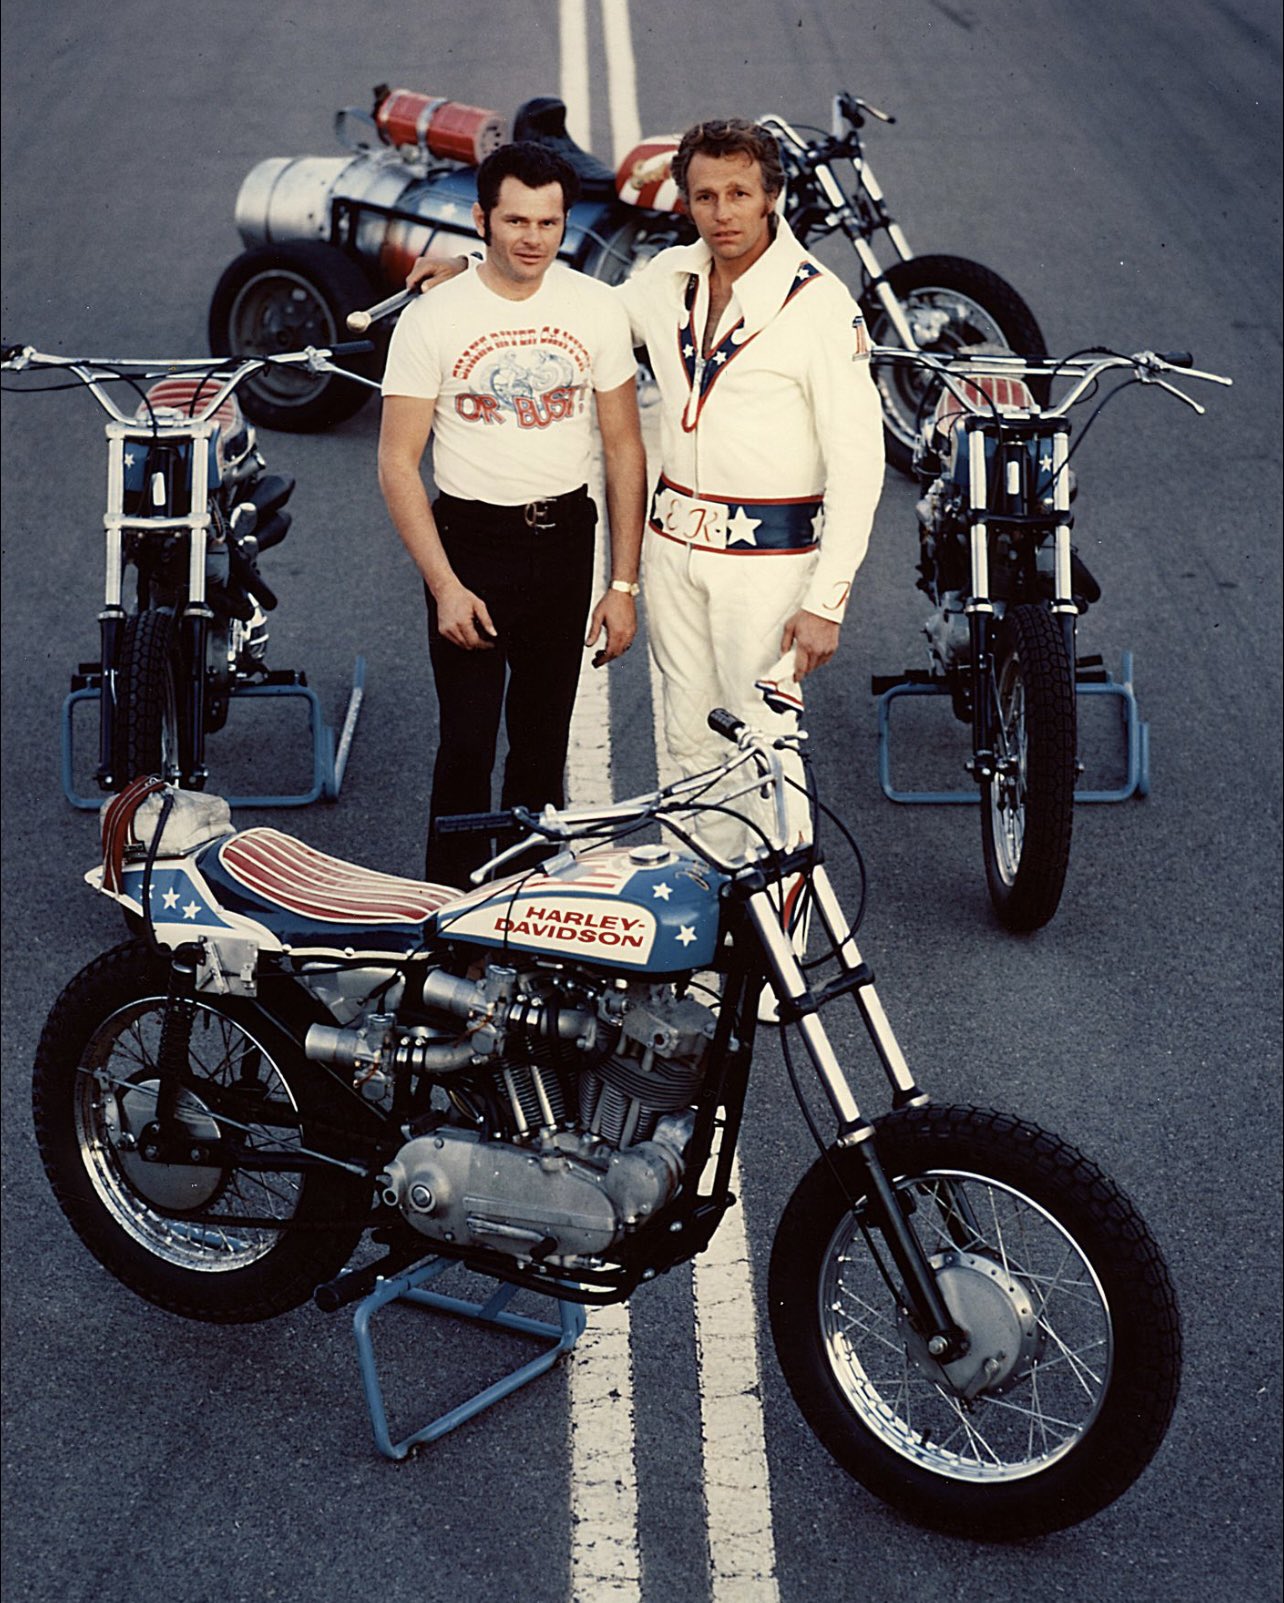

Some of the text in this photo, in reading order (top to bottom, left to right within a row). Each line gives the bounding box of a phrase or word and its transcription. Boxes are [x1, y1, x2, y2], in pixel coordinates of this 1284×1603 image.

[455, 392, 506, 425] OR
[494, 917, 644, 947] DAVIDSON
[526, 906, 645, 931] HARLEY-
